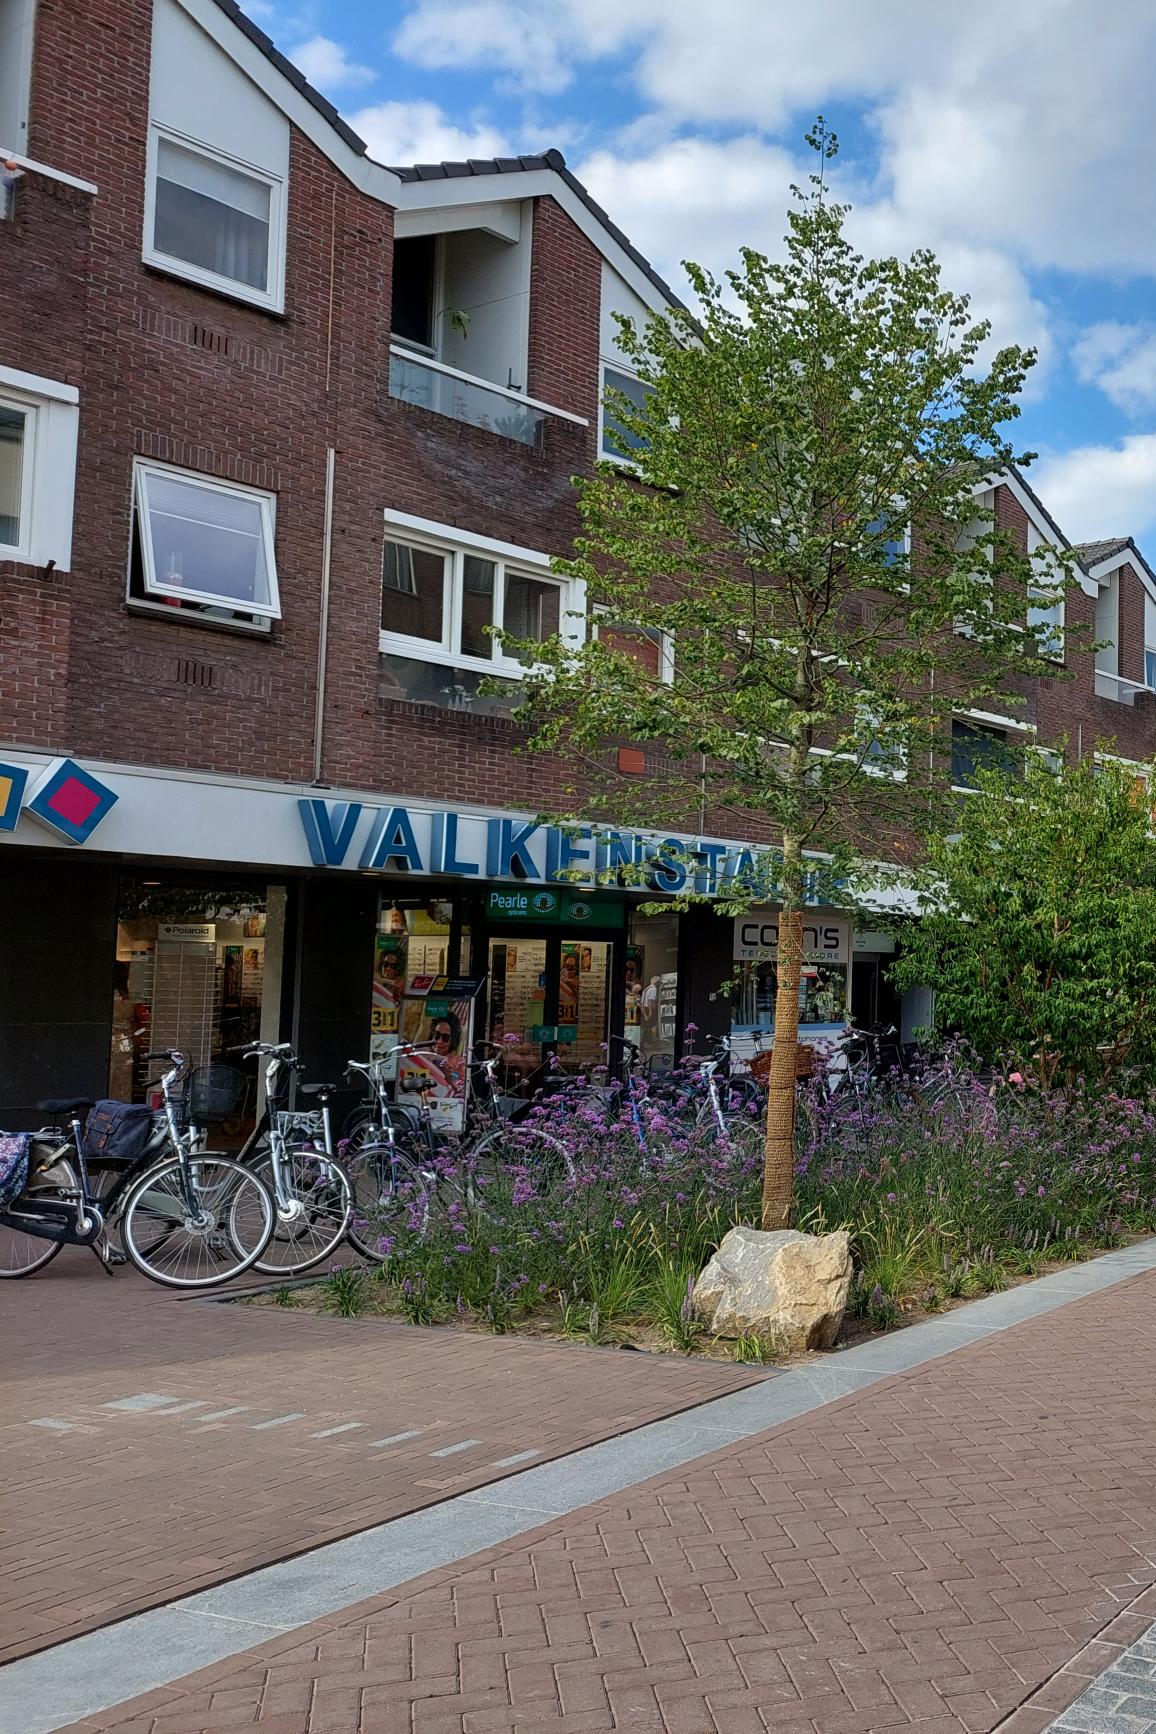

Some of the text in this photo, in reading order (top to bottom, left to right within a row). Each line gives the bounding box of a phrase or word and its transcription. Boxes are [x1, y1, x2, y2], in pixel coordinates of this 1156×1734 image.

[297, 798, 850, 906] VALKENSTA
[490, 892, 527, 908] Pearle
[173, 926, 209, 934] Polaroid
[798, 1035, 828, 1043] tphones
